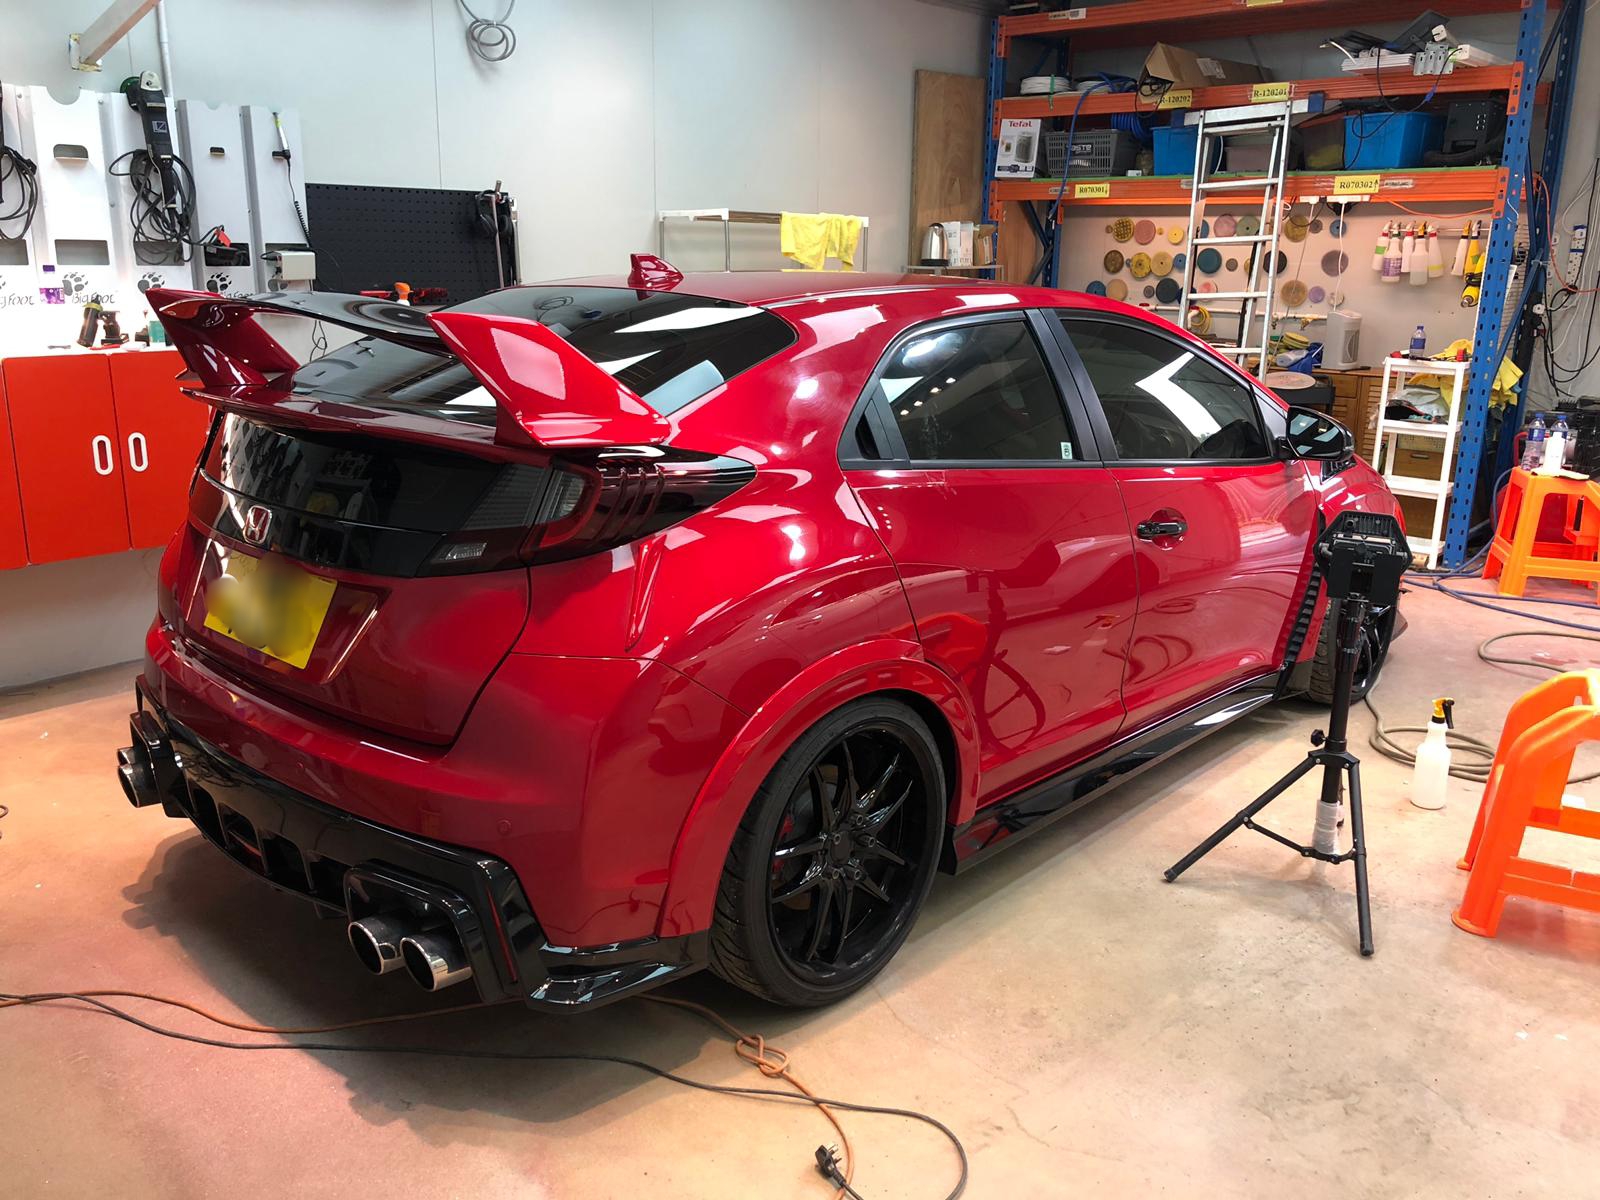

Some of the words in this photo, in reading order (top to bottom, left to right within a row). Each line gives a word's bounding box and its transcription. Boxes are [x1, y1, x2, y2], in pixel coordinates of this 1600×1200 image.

[1253, 87, 1287, 97] R-120201
[1079, 186, 1105, 194] R070301
[1339, 180, 1373, 190] R070302
